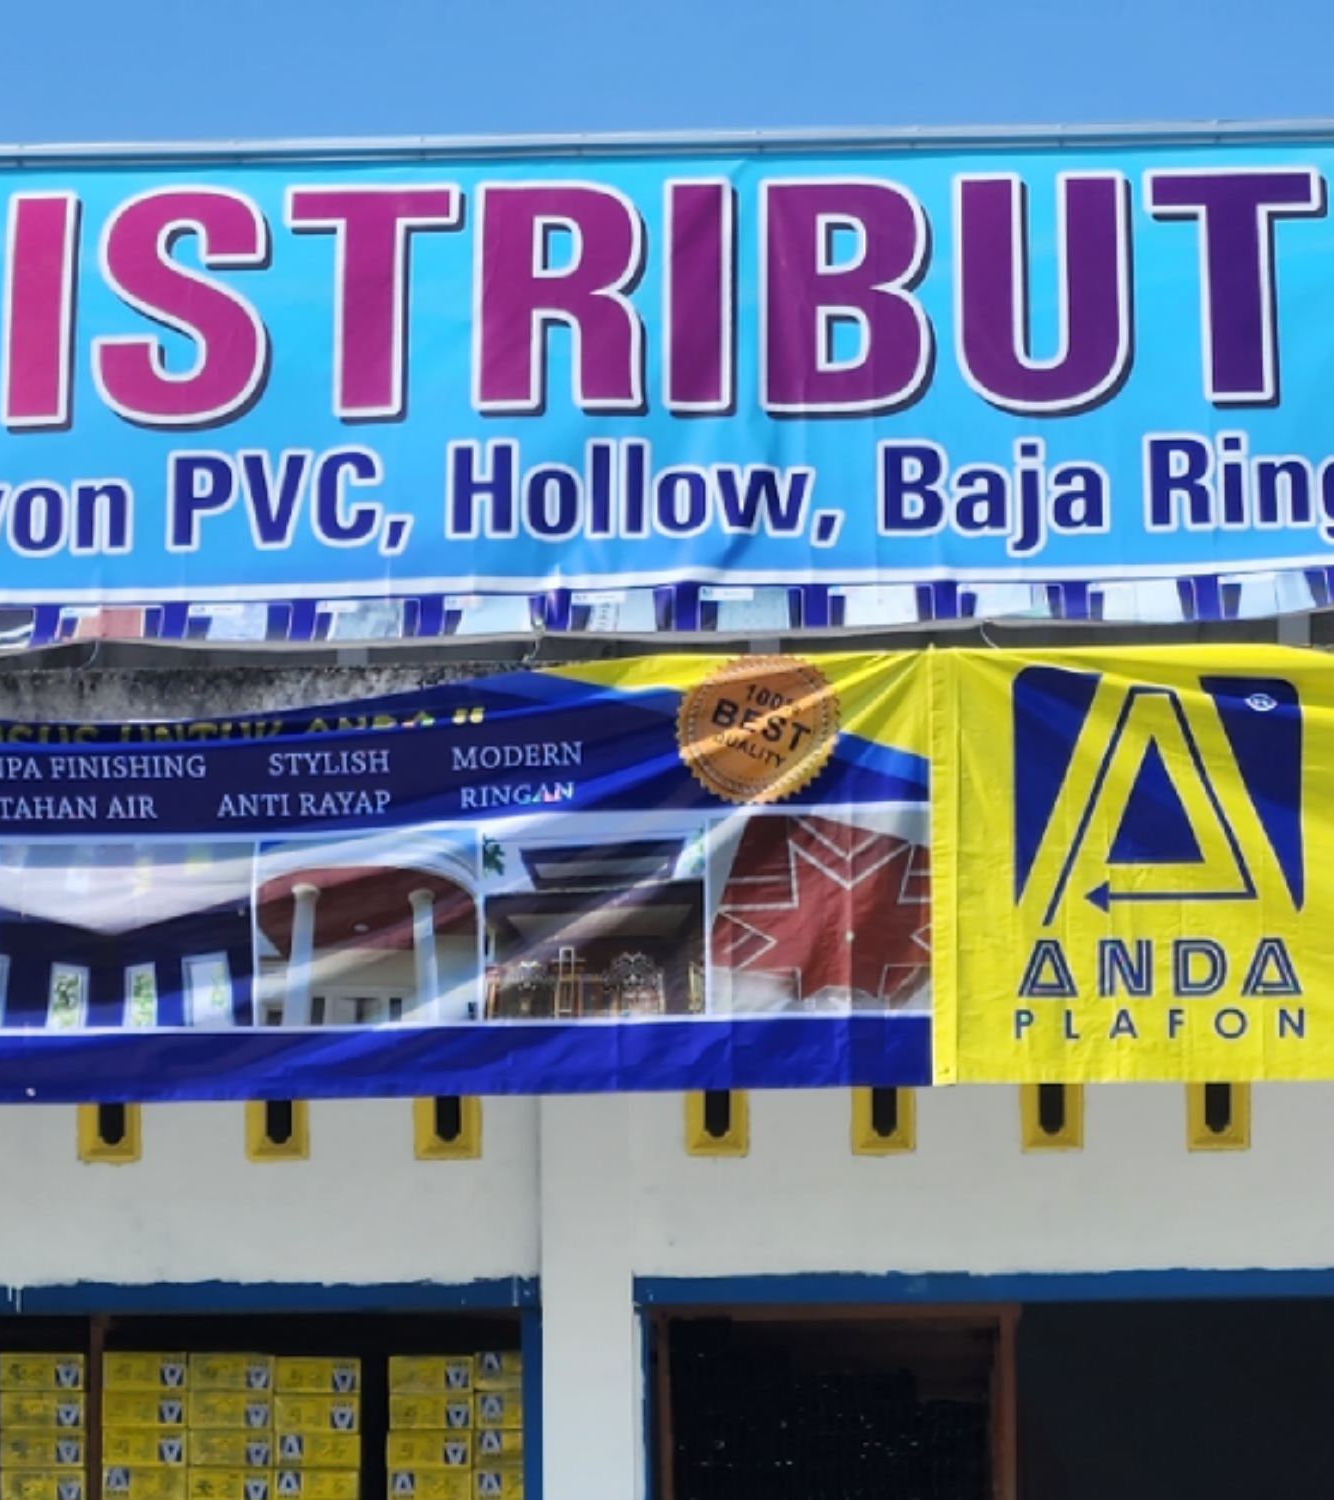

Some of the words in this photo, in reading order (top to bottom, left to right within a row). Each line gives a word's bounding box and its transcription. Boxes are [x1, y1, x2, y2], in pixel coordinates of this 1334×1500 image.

[169, 448, 411, 552] PVC,
[449, 440, 842, 544] Hollow,
[879, 439, 1106, 555] Baja
[711, 698, 811, 751] BEST
[49, 753, 208, 779] FINISHING
[267, 747, 391, 777] STYLISH
[451, 740, 584, 772] MODERN
[106, 795, 158, 820] AIR
[216, 792, 294, 819] ANTI
[299, 790, 391, 817] RAYAP
[459, 780, 575, 809] RINGAN
[1017, 938, 1303, 998] ANDA
[1014, 1008, 1306, 1040] PLAFON
